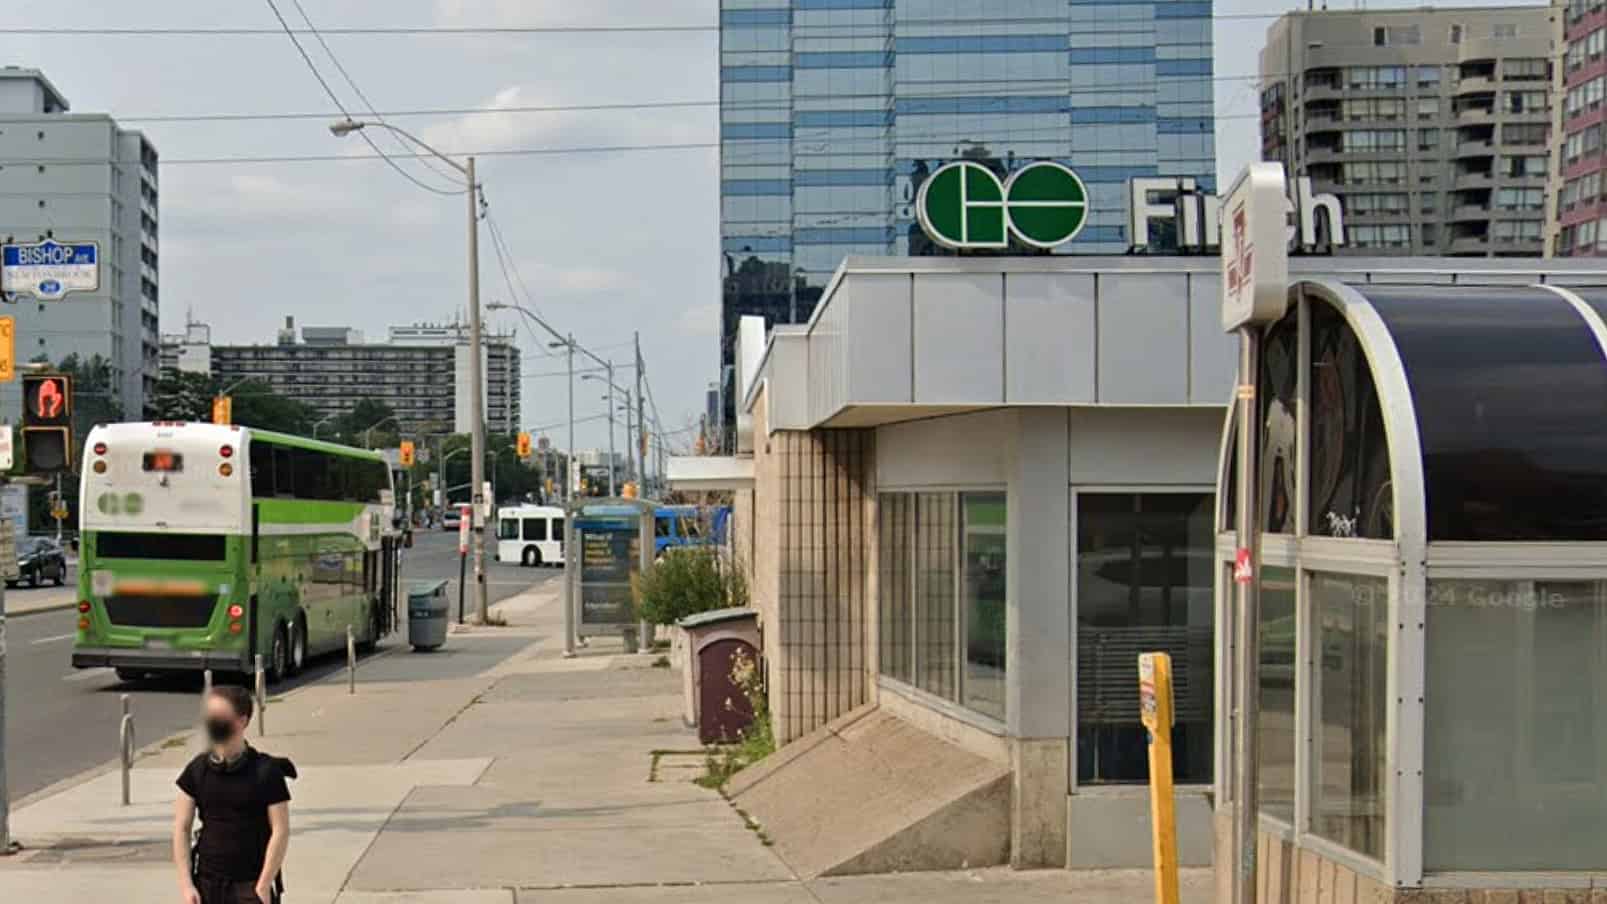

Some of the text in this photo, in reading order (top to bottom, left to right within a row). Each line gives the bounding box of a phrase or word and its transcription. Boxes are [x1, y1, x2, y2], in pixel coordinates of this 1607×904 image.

[916, 160, 1089, 249] GO
[1131, 176, 1344, 247] Fih
[18, 246, 74, 265] BISHOP
